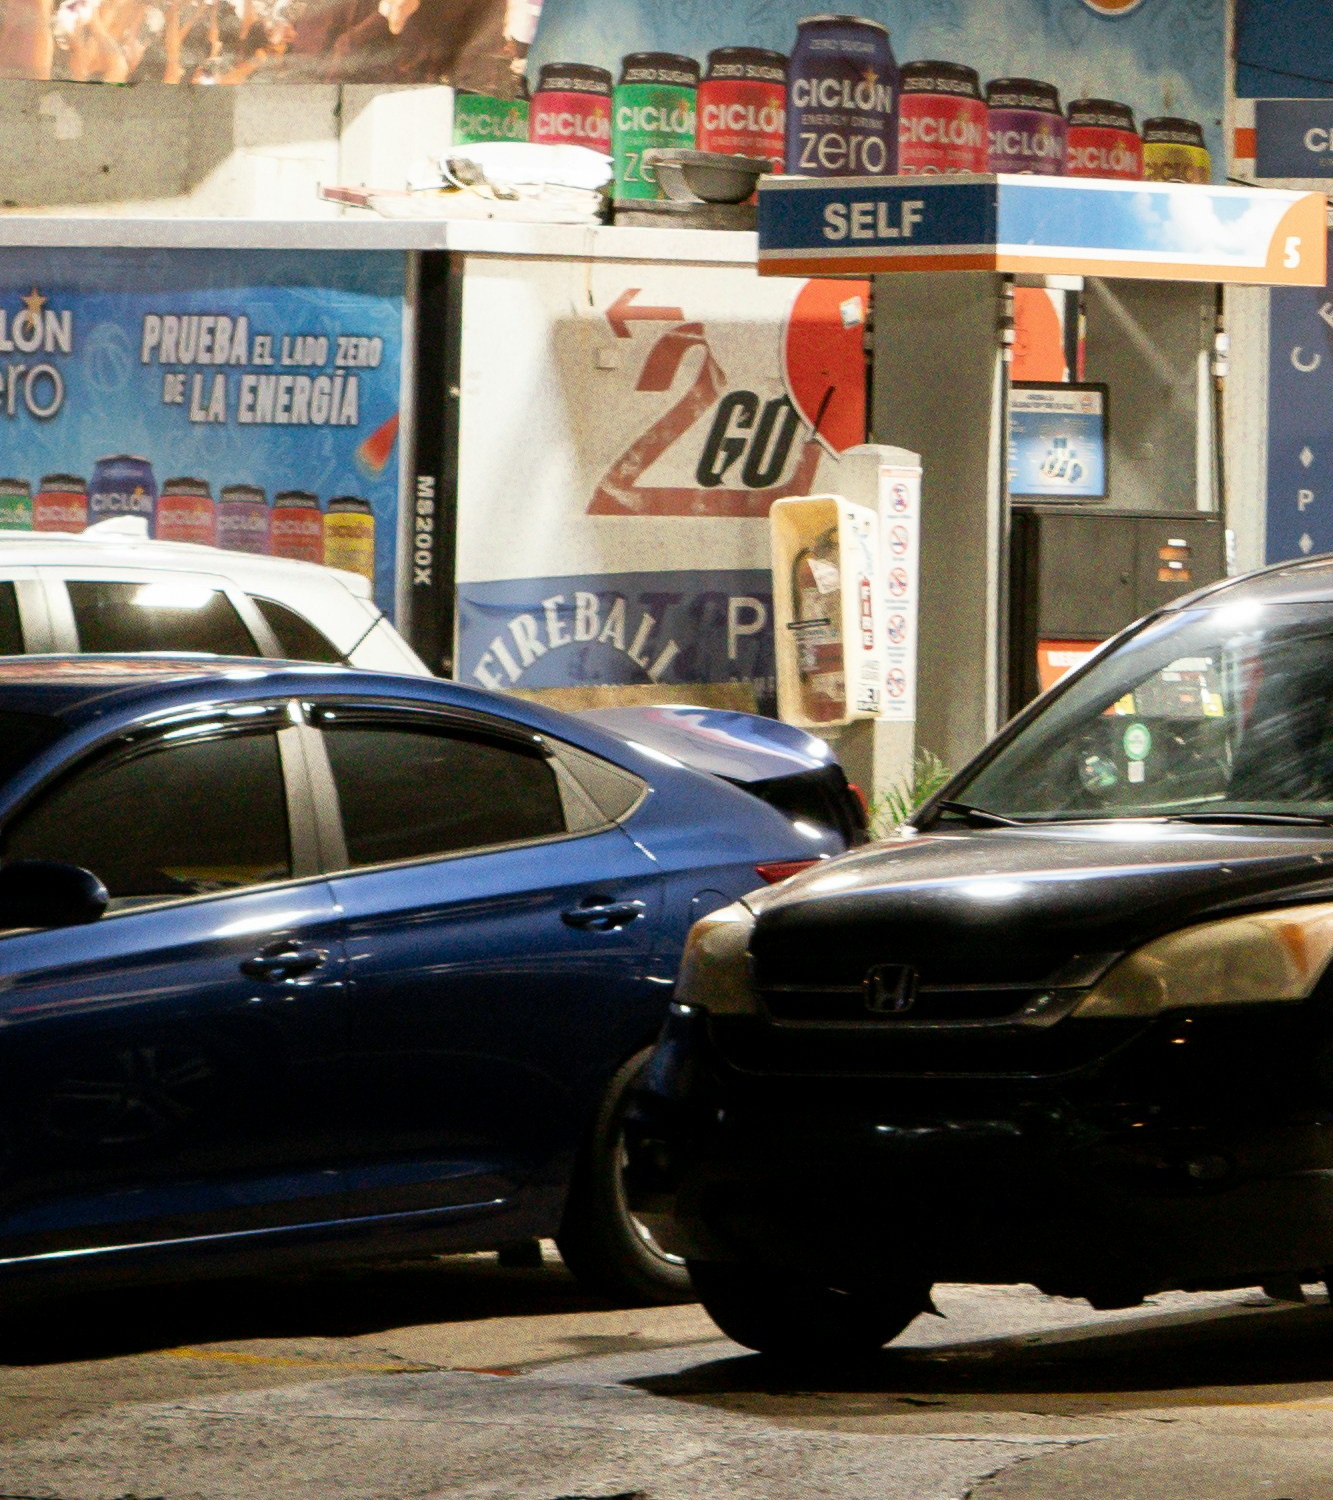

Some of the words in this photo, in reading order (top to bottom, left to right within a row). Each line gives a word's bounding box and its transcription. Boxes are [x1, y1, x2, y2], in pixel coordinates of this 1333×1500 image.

[799, 131, 887, 173] zero
[823, 200, 925, 242] SELF
[1283, 236, 1302, 269] 5
[141, 314, 249, 365] PRUEBA
[252, 334, 275, 366] EL
[280, 335, 329, 366] LADO
[333, 335, 384, 368] ZERO
[162, 372, 188, 405] DE
[189, 372, 227, 424] LA
[237, 368, 360, 425] ENERGÍA
[696, 389, 802, 489] GO
[1297, 489, 1314, 511] P
